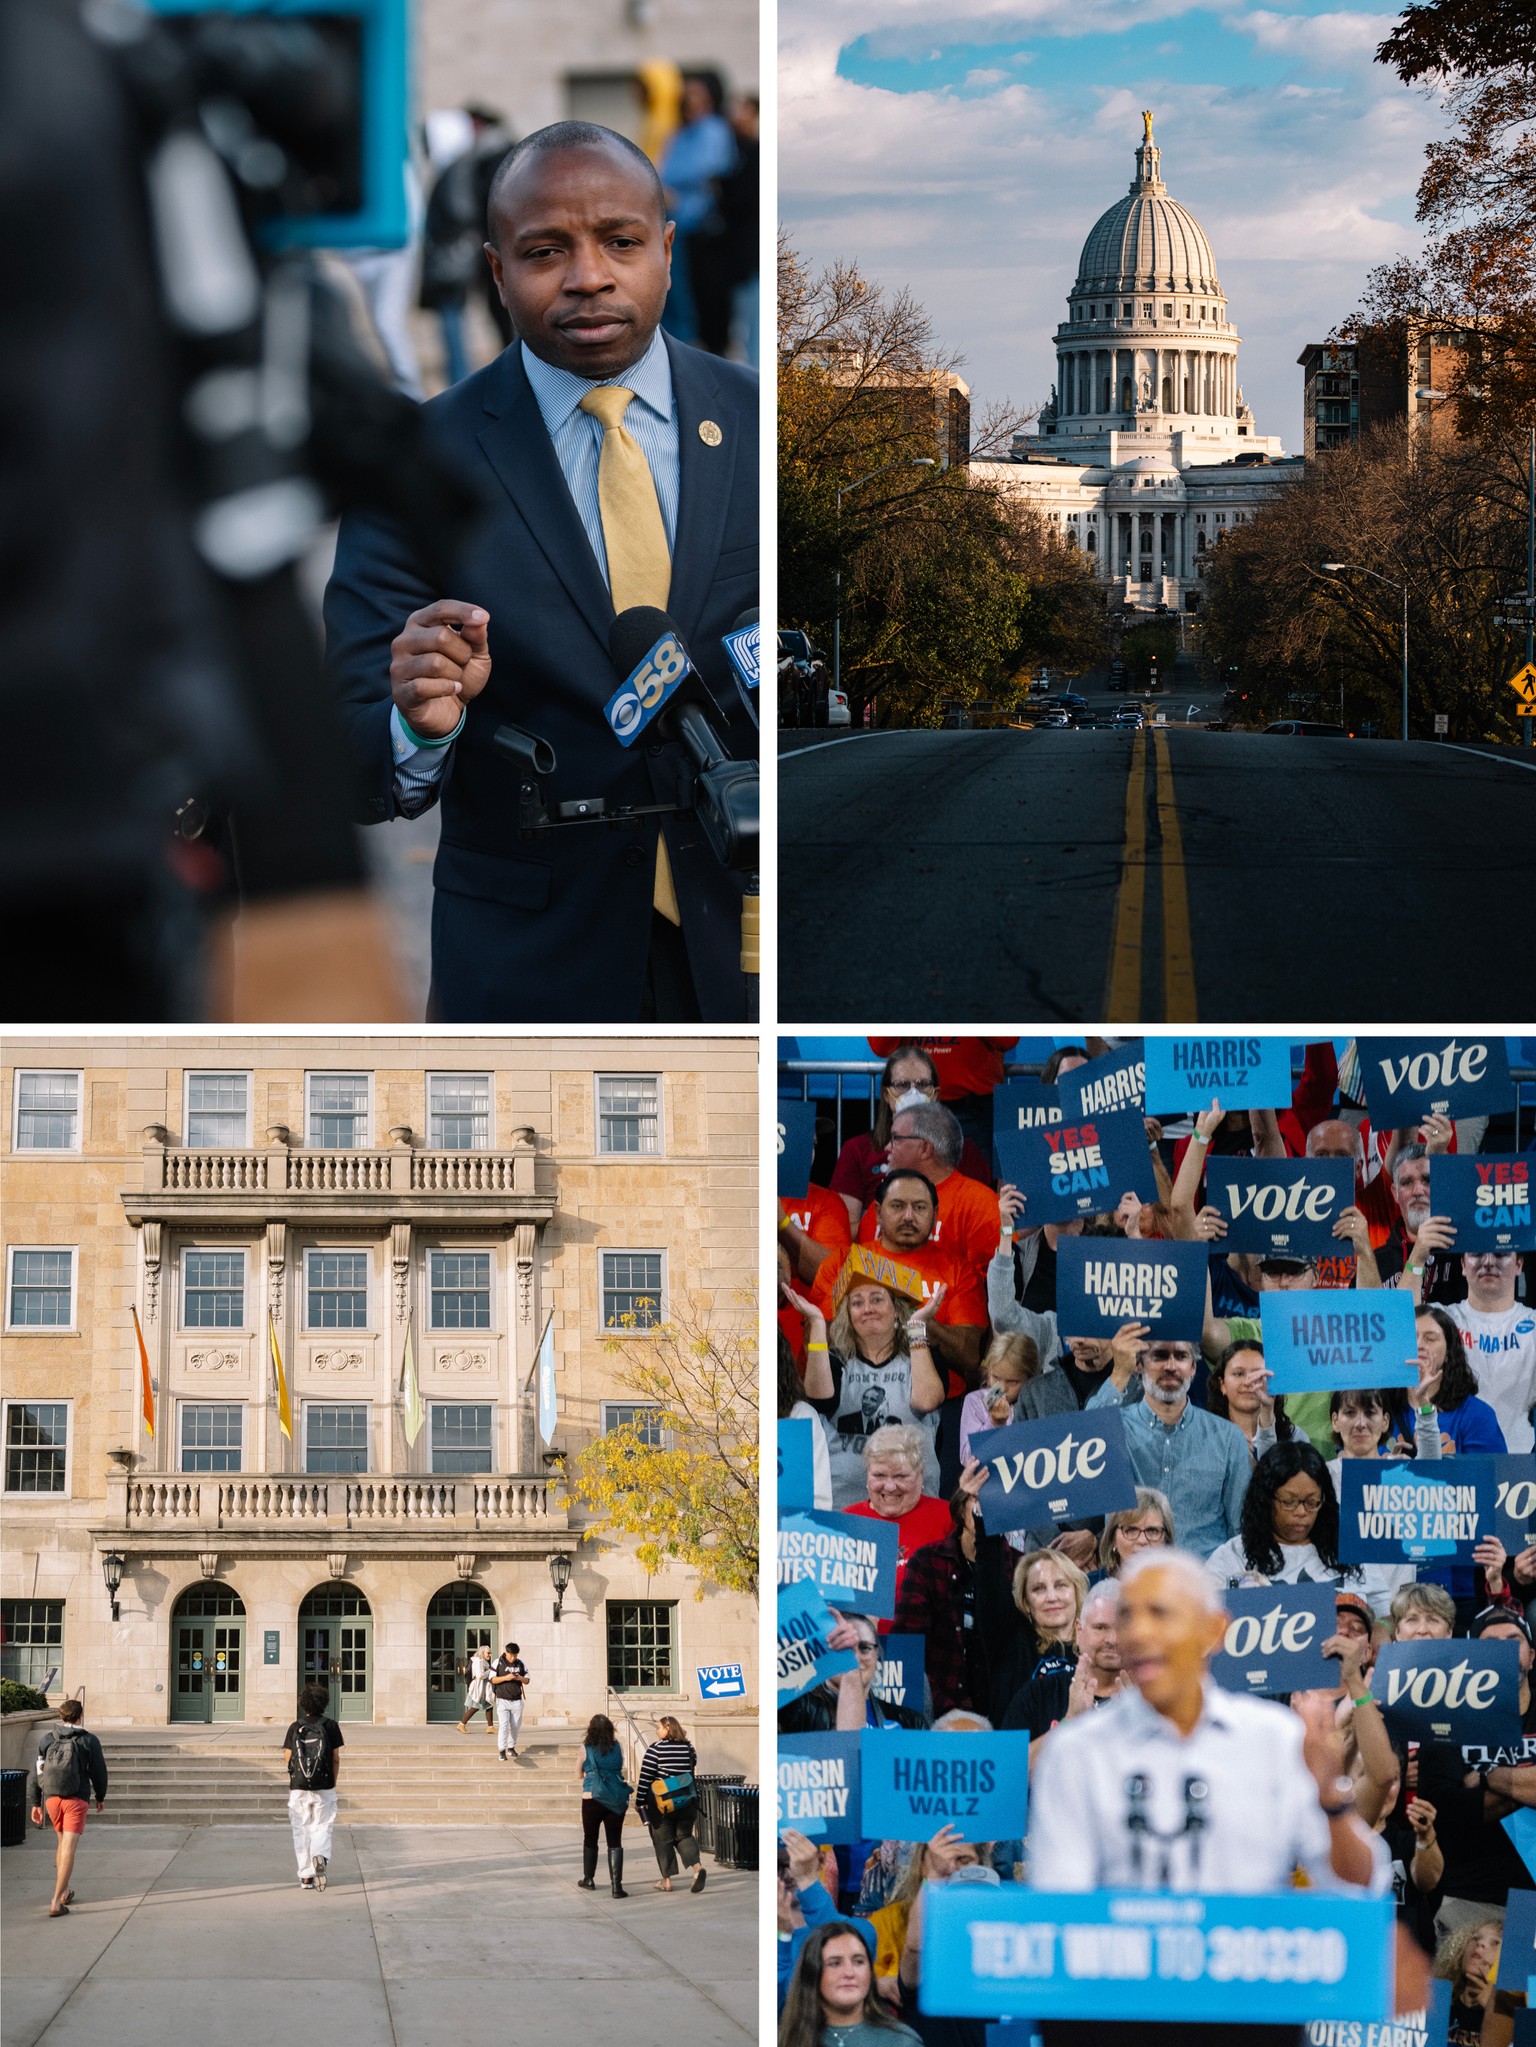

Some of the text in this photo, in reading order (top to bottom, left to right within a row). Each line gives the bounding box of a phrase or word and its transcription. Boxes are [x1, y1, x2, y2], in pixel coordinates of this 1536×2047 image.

[633, 640, 685, 709] 58
[1173, 1038, 1262, 1072] HARRIS
[1378, 1038, 1488, 1095] vote
[1079, 1062, 1146, 1117] HARRIS
[1186, 1069, 1249, 1089] WALZ
[1043, 1124, 1099, 1153] YES
[1048, 1144, 1104, 1175] SHE
[1475, 1161, 1530, 1185] YES
[1051, 1164, 1111, 1196] CAN
[1475, 1182, 1530, 1206] SHE
[1225, 1175, 1336, 1222] vote
[1474, 1204, 1532, 1228] CAN
[857, 1244, 919, 1299] WALZ
[1084, 1261, 1178, 1298] HARRIS
[1097, 1296, 1163, 1318] WALZ
[1292, 1313, 1386, 1346] HARRIS
[1308, 1346, 1373, 1366] WALZ
[991, 1432, 1107, 1494] vote
[1362, 1484, 1477, 1513] WISCONSIN
[1357, 1511, 1480, 1540] VOTES EARLY
[821, 1562, 879, 1593] EARLY
[1224, 1603, 1317, 1658] ote
[698, 1665, 741, 1681] VOTE
[1387, 1658, 1500, 1710] vote
[893, 1757, 996, 1793] HARRIS
[787, 1788, 849, 1819] EARLY
[909, 1795, 980, 1816] WALZ
